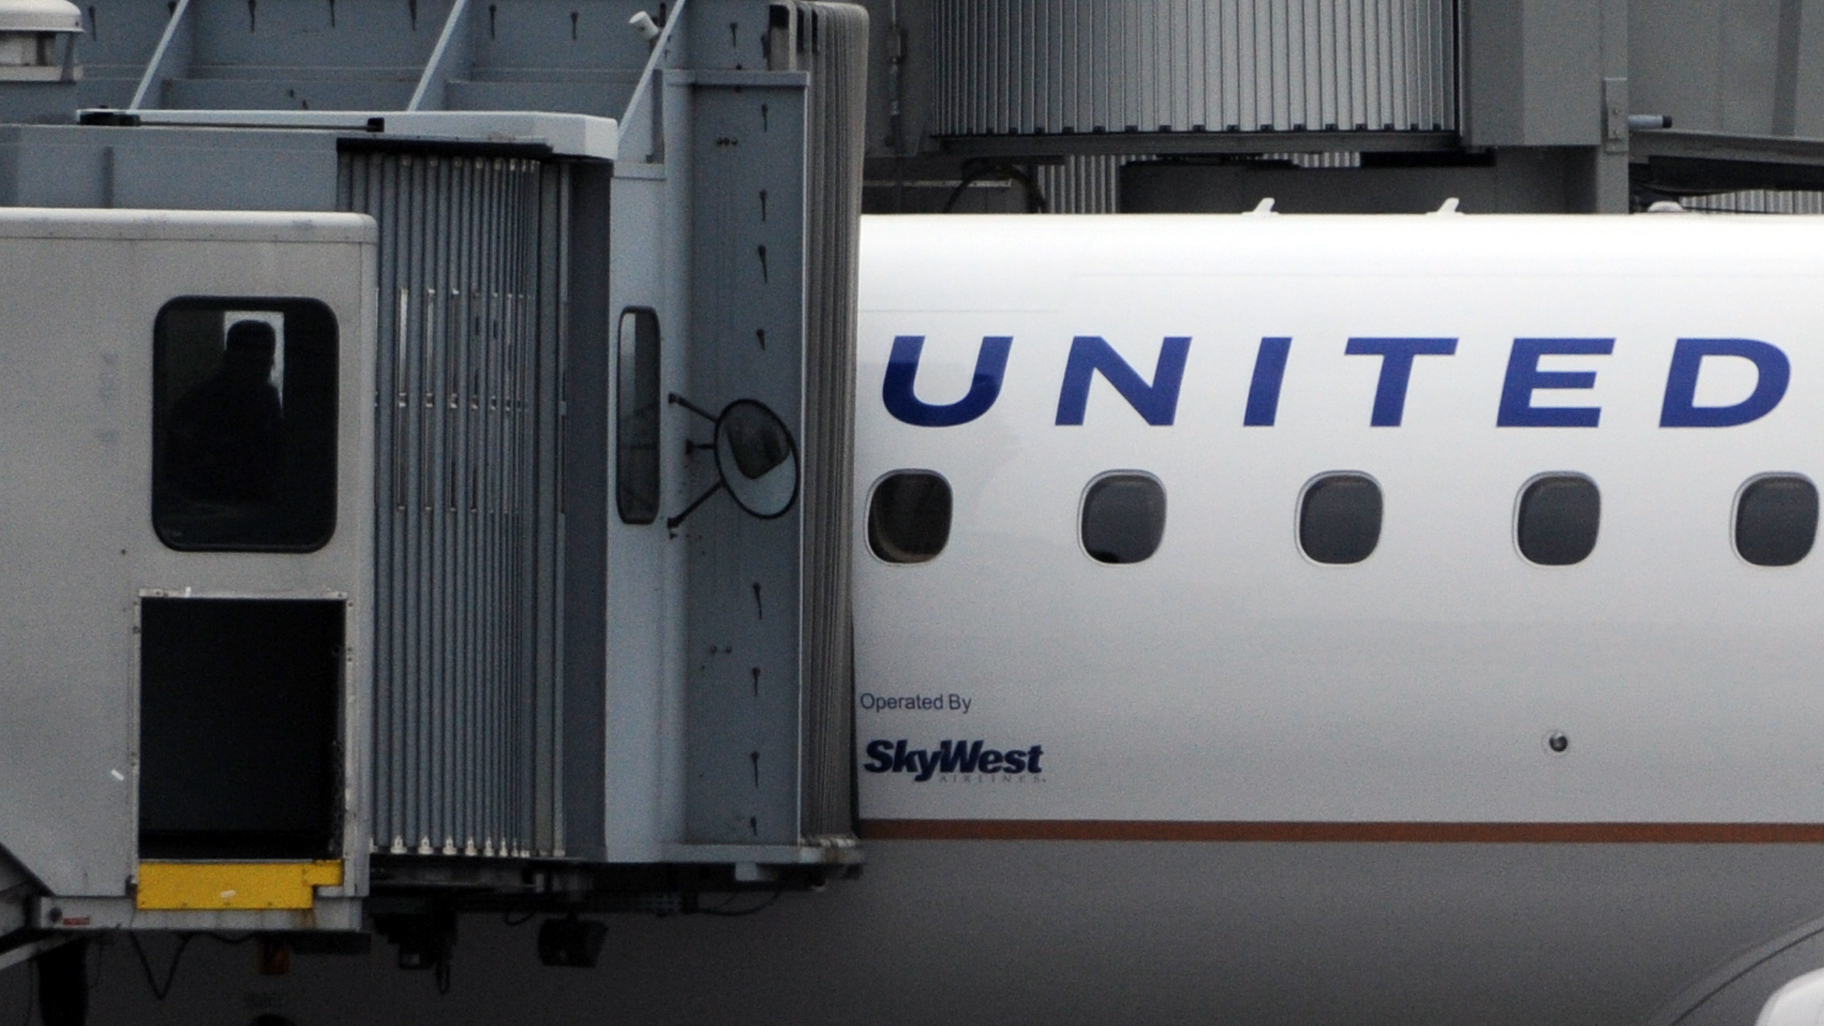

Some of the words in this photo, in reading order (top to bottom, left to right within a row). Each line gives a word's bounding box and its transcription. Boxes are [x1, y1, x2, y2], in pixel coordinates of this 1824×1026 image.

[880, 335, 1792, 428] UNITED
[860, 693, 943, 712] Operated
[949, 694, 972, 714] By
[863, 739, 1044, 782] SkyWest
